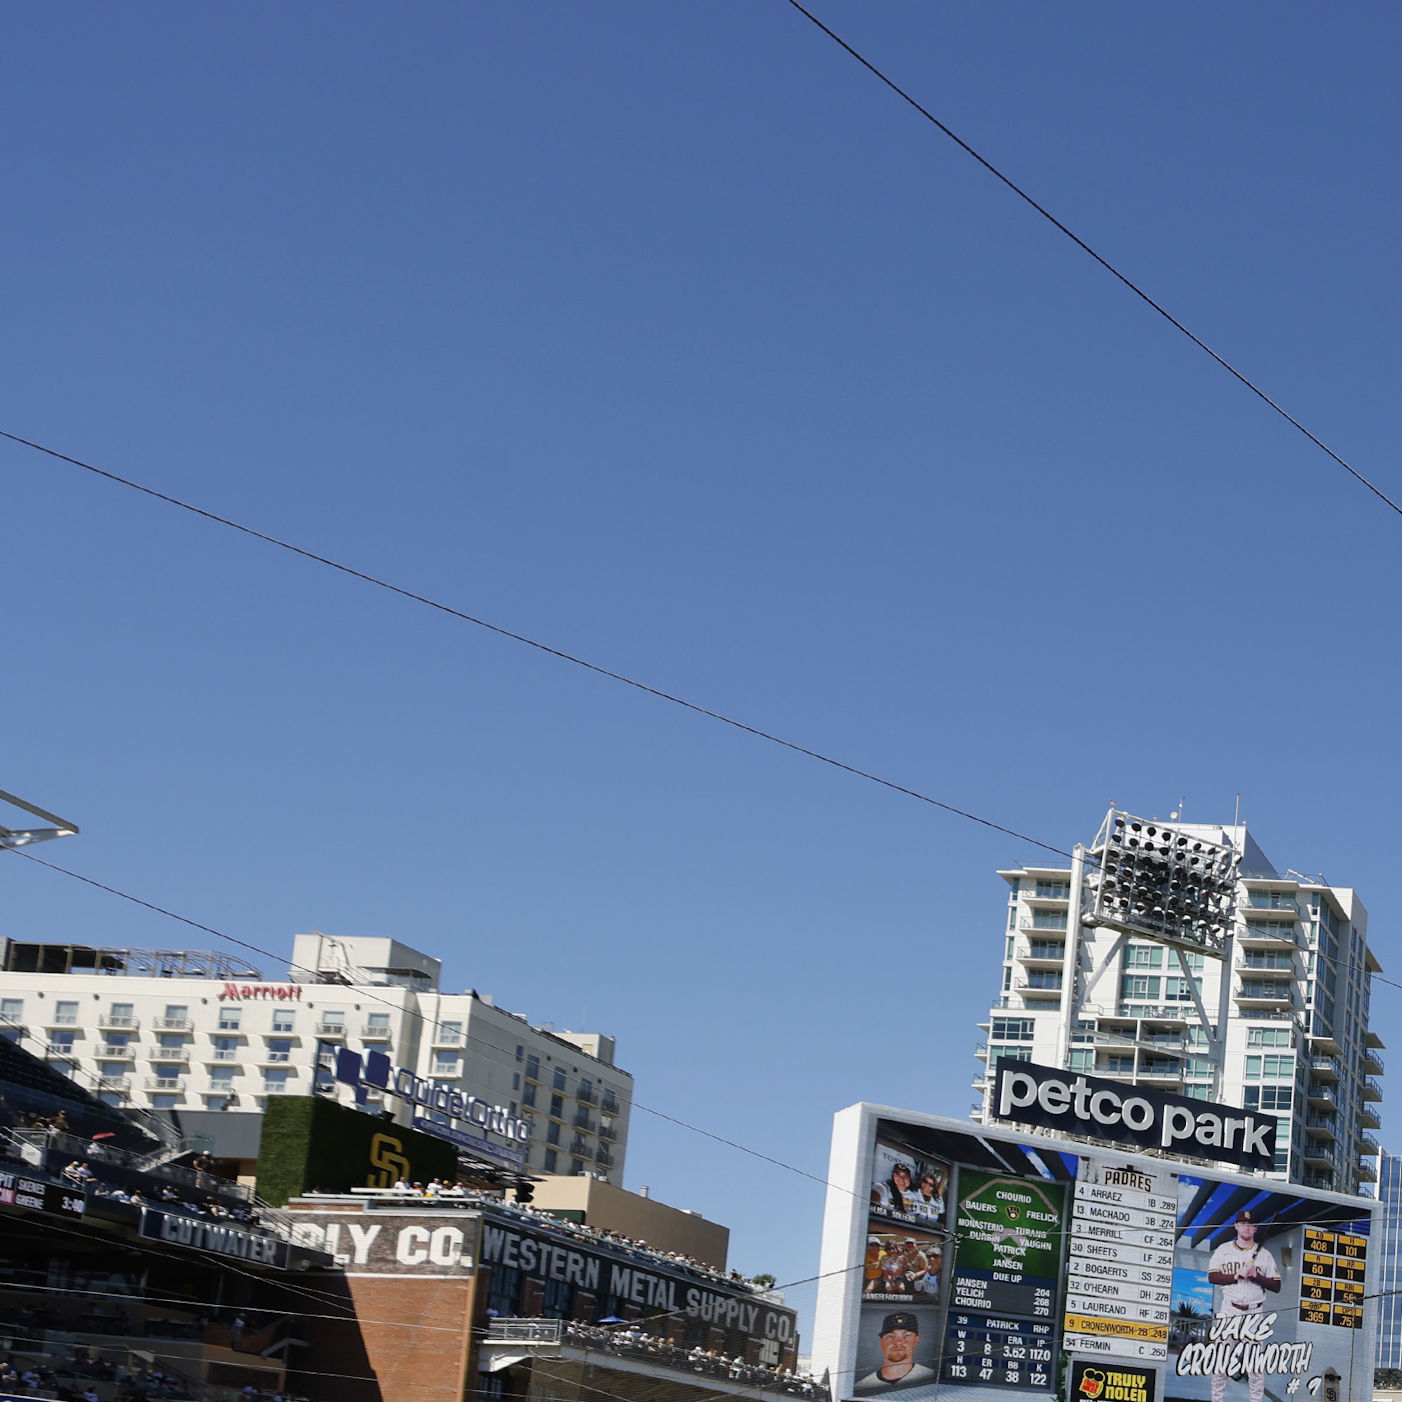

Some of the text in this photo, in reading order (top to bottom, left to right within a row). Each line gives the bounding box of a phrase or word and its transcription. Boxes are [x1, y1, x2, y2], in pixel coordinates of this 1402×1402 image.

[217, 983, 302, 1001] Marriott
[395, 1067, 530, 1143] QuidelOrtho
[1000, 1070, 1273, 1157] petco park
[1105, 1171, 1152, 1192] PADRES
[996, 1191, 1032, 1203] CHOURIO
[1091, 1189, 1122, 1202] ARRAEZ
[965, 1200, 997, 1213] BAUERS
[1026, 1211, 1058, 1223] FRELICK
[1089, 1207, 1130, 1221] MACHADO
[958, 1218, 1004, 1232] MONASTERIO
[161, 1213, 278, 1265] CUTWATER
[1088, 1226, 1123, 1239] MERRILL
[396, 1225, 472, 1267] CO.
[993, 1245, 1026, 1256] PATRICK
[1020, 1239, 1052, 1250] VAUGHN
[1086, 1245, 1117, 1257] SHEETS
[1310, 1240, 1327, 1252] 408
[993, 1259, 1023, 1270] JANSEN
[1085, 1264, 1128, 1277] BOGAERTS
[482, 1224, 793, 1343] WESTERN METAL SUPPLY CO.
[956, 1277, 988, 1290] JANSEN
[993, 1272, 1022, 1283] DUE UP
[956, 1287, 984, 1298] YELICH
[1084, 1282, 1119, 1295] O'HEARN
[955, 1296, 992, 1309] CHOURIO
[1082, 1301, 1126, 1315] LAUREANO
[957, 1316, 1050, 1334] 39 PATRICK RHP
[1081, 1320, 1134, 1335] CRONENWORTH
[1209, 1312, 1278, 1342] JAKE
[1007, 1336, 1023, 1345] ERA
[1080, 1340, 1111, 1351] FERMIN
[1003, 1346, 1026, 1359] 3.62
[1176, 1341, 1314, 1377] CRONENWORTH
[951, 1365, 1047, 1385] 113 47 38 122
[1106, 1371, 1147, 1388] TRULY
[1105, 1386, 1147, 1402] NOLEN
